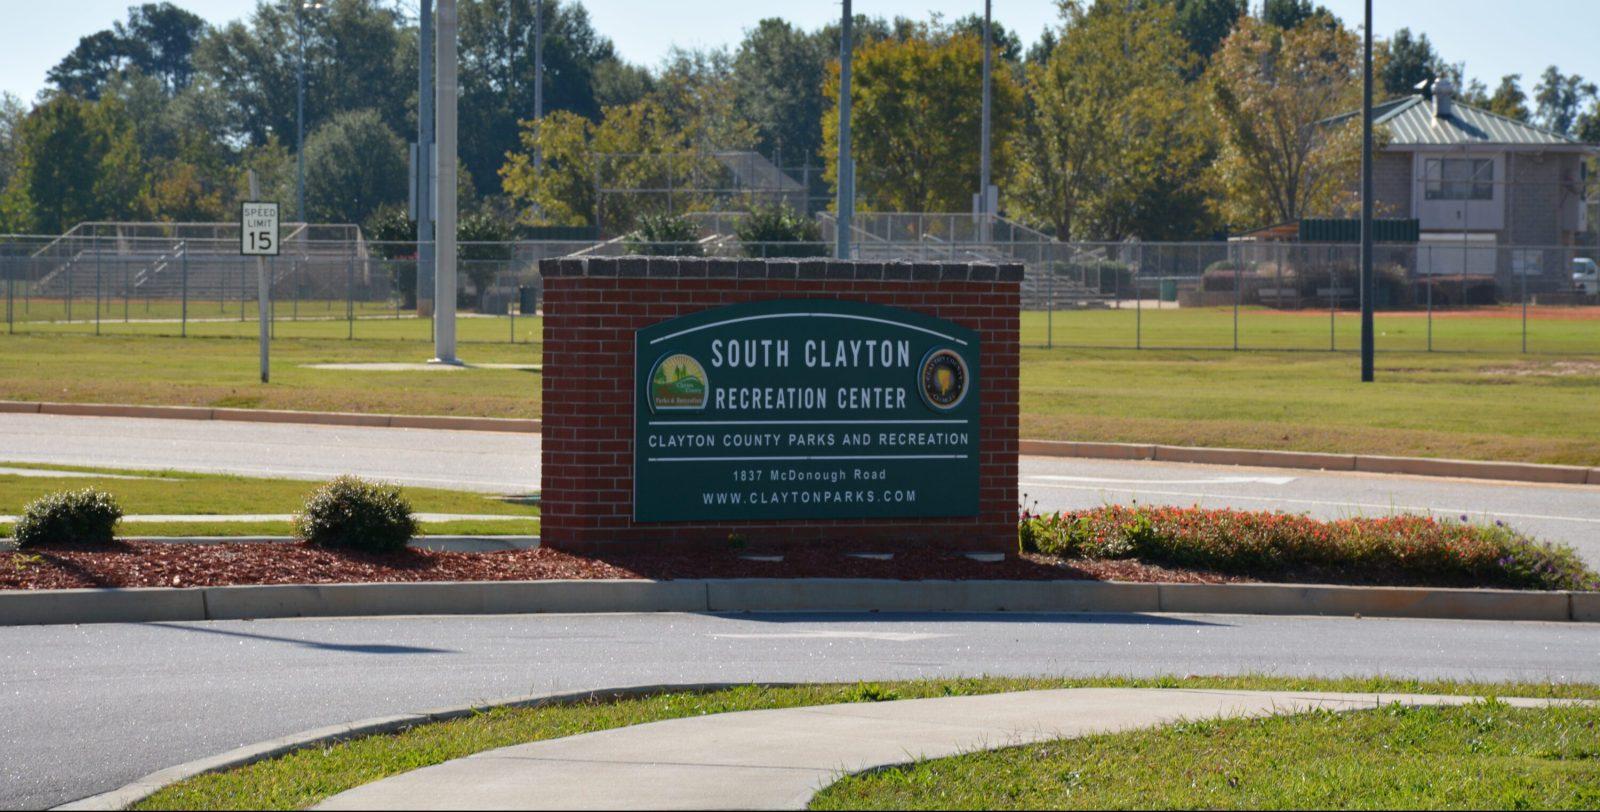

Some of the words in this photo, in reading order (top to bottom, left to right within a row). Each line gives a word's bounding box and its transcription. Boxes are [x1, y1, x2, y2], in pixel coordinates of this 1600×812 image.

[244, 208, 276, 217] SPEED
[247, 219, 272, 228] LIMIT
[249, 231, 272, 250] 15
[711, 339, 789, 368] SOUTH
[804, 339, 910, 368] CLAYTON
[715, 387, 827, 410] RECREATION
[837, 387, 906, 409] CENTER
[648, 434, 715, 448] CLAYTON
[723, 433, 781, 447] COUNTY
[788, 433, 835, 446] PARKS
[842, 433, 871, 446] AND
[879, 432, 968, 446] RECREATION
[733, 469, 763, 481] 1837
[770, 469, 846, 483] McDonough
[854, 468, 886, 480] Road
[703, 489, 916, 505] WWW.CLAYTONPARKS.COM
